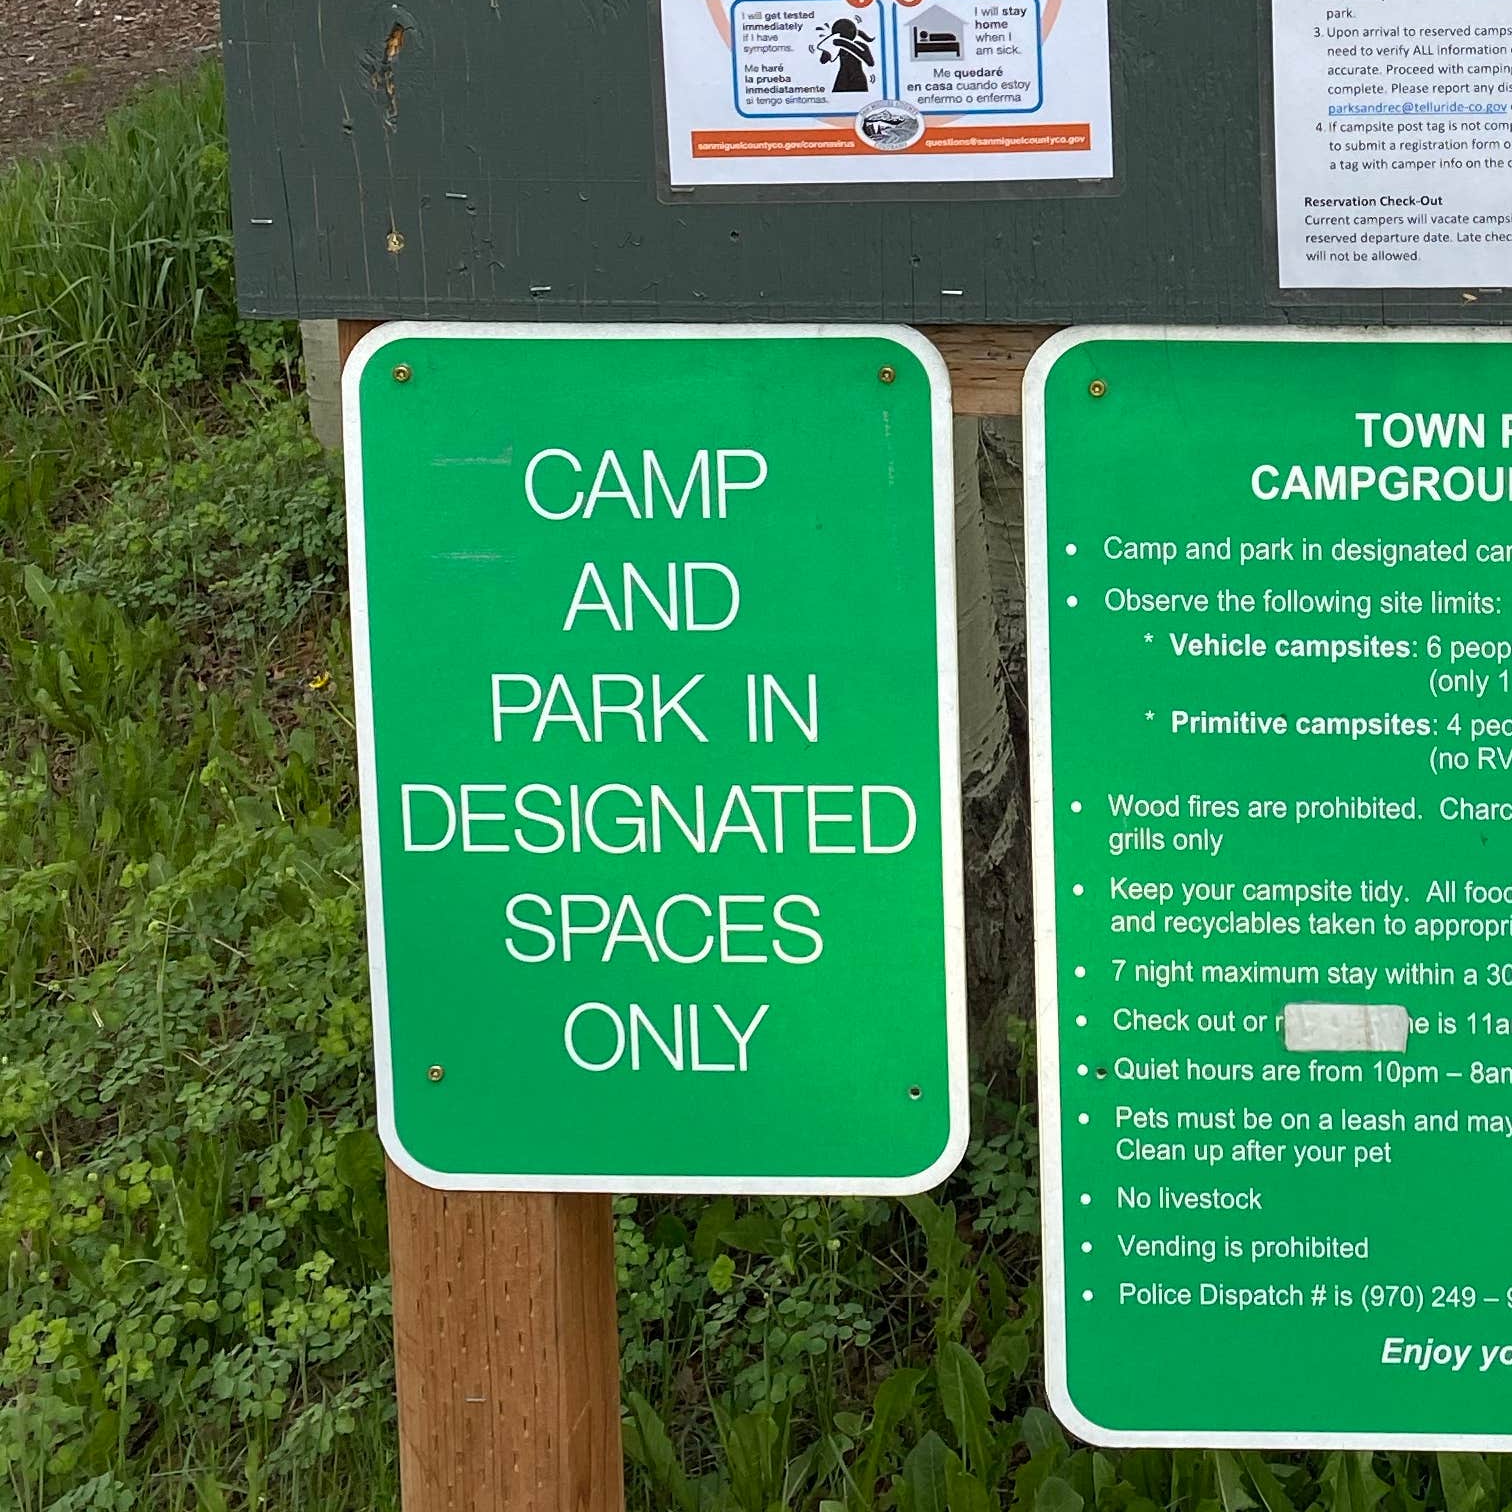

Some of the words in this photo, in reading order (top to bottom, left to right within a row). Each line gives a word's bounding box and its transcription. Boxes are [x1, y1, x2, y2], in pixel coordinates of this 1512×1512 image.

[974, 19, 1009, 30] home
[981, 7, 999, 17] will
[1001, 6, 1028, 18] stay
[1328, 101, 1508, 117] parksandrec@telluride-co.gov
[1304, 196, 1377, 207] Reservation
[1379, 195, 1443, 207] Check-Out
[1356, 413, 1484, 448] TOWN
[525, 449, 767, 520] CAMP
[1103, 535, 1177, 566] Camp
[1185, 536, 1231, 561] and
[1240, 537, 1294, 566] park
[1302, 537, 1323, 561] in
[1331, 537, 1467, 568] designated
[563, 562, 739, 630] AND
[1104, 587, 1209, 612] Observe
[1216, 588, 1256, 613] the
[1262, 588, 1371, 619] following
[1380, 590, 1423, 614] site
[1431, 590, 1501, 615] limits:
[1169, 632, 1267, 657] Vehicle
[1275, 634, 1418, 663] campsites:
[1426, 635, 1442, 659] 6
[1429, 668, 1490, 698] (only
[1498, 669, 1508, 693] 1
[492, 674, 708, 742] PARK
[748, 674, 818, 742] IN
[1171, 710, 1288, 735] Primitive
[1295, 712, 1438, 741] campsites:
[1446, 712, 1462, 736] 4
[1429, 746, 1469, 775] (no
[402, 784, 916, 854] DESIGNATED
[506, 894, 823, 964] SPACES
[1113, 1007, 1190, 1032] Check
[1197, 1010, 1236, 1032] out
[1243, 1014, 1268, 1033] or
[1437, 1011, 1457, 1035] is
[565, 1002, 769, 1071] ONLY
[1117, 1186, 1152, 1209] No
[1159, 1186, 1263, 1210] livestock
[1117, 1234, 1216, 1263] Vending
[1224, 1235, 1243, 1258] is
[1251, 1235, 1369, 1263] prohibited
[1382, 1338, 1472, 1370] Enjoy
